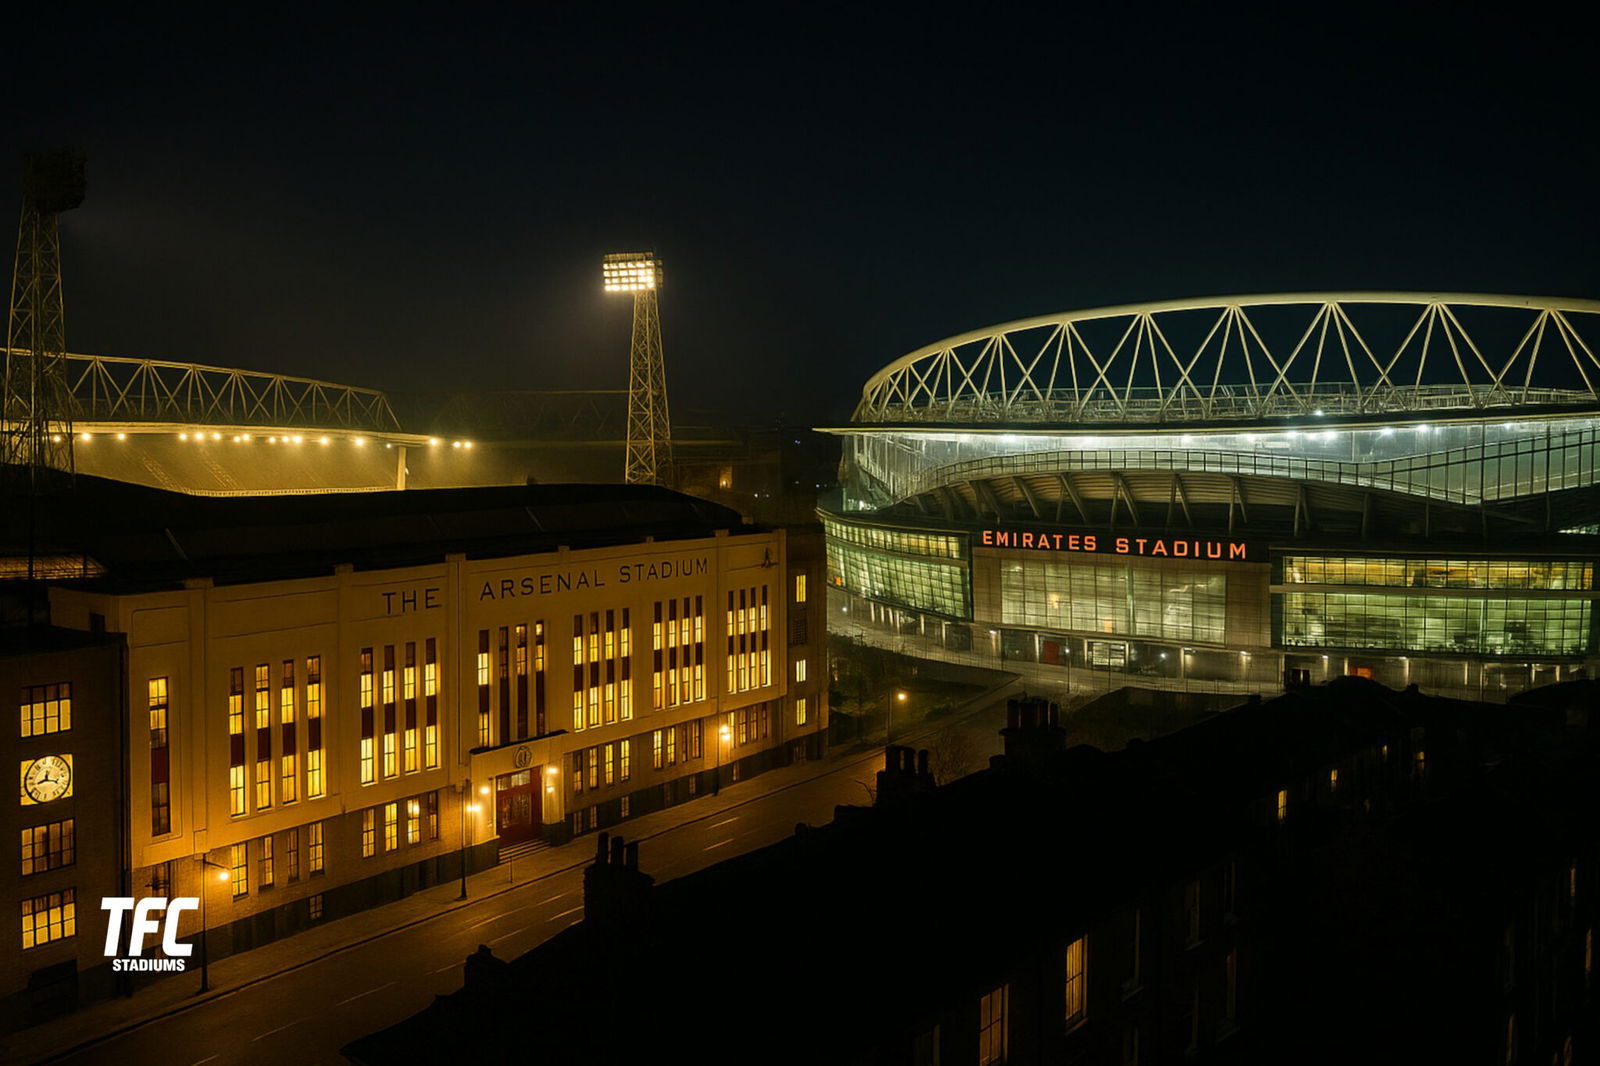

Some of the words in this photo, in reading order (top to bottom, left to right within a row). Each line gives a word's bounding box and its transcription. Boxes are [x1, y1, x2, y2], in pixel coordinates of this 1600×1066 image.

[981, 529, 1097, 552] EMIRATES
[1115, 537, 1247, 560] STADIUM
[381, 588, 441, 615] THE
[479, 568, 606, 601] ARSENAL
[619, 557, 709, 583] STADIUM
